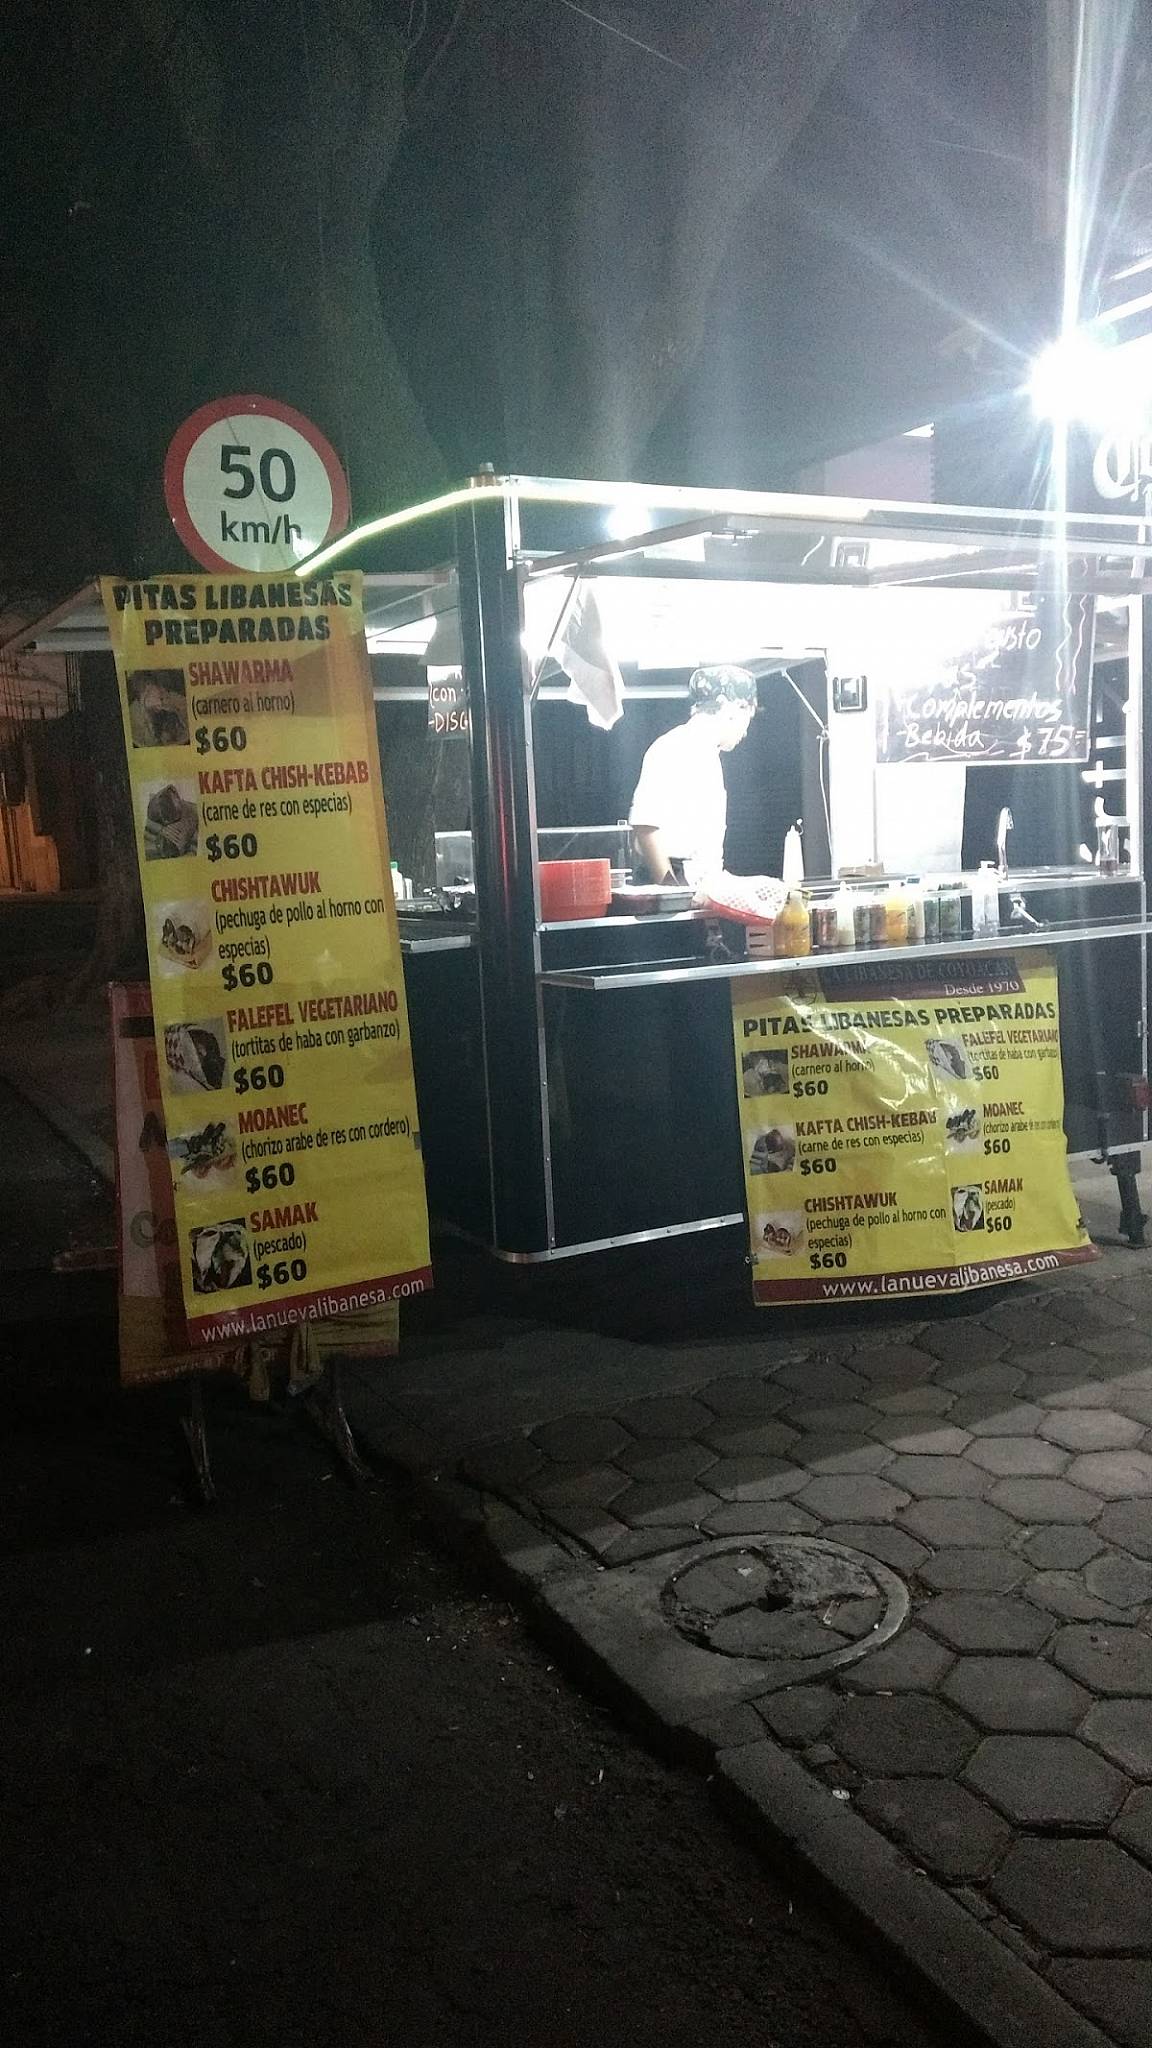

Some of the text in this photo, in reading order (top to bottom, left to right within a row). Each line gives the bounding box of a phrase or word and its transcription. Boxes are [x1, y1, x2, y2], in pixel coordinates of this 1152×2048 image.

[219, 444, 297, 503] 50
[220, 511, 302, 544] km/h
[112, 580, 352, 612] PITAS LIBANESAS
[144, 616, 331, 646] PREPARADAS
[188, 658, 295, 687] SHAWARMA
[192, 684, 296, 720] (carnero al horno)
[195, 726, 247, 756] $60
[198, 760, 369, 795] KAFTA CHISH-KEBAB
[202, 793, 352, 825] (carne de res con especias)
[205, 832, 258, 863] $60
[211, 871, 321, 902] CHISHTAWUK
[215, 897, 385, 933] (pechuga de pollo al horno con
[218, 938, 271, 962] especias)
[222, 961, 273, 992] $60
[945, 979, 1019, 997] Desde 1970
[226, 990, 398, 1033] FALEFEL VEGETARIANO
[743, 1002, 1056, 1037] PITAS LIBANESAS PREPARADAS
[231, 1019, 400, 1061] (tortitas de haba con garbanzo)
[962, 1031, 1005, 1047] FALEFEL
[233, 1064, 285, 1096] $60
[792, 1064, 832, 1078] (carnero
[834, 1061, 843, 1073] al
[972, 1065, 999, 1081] $60
[792, 1080, 828, 1098] $60
[237, 1102, 308, 1135] MOANEC
[796, 1110, 937, 1136] KAFTA CHISH-KEBAB
[983, 1101, 1024, 1118] MOANEC
[241, 1115, 410, 1161] (chorizo arabe de res con cordero)
[798, 1130, 924, 1155] (carne de res con especias)
[984, 1138, 1011, 1155] $60
[245, 1162, 295, 1194] $60
[800, 1157, 837, 1176] $60
[984, 1178, 1024, 1195] SAMAK
[250, 1201, 319, 1234] SAMAK
[804, 1192, 897, 1213] CHISHTAWUK
[986, 1197, 1015, 1214] (pescado)
[806, 1208, 946, 1232] (pechuga de pollo al horno con
[986, 1216, 1012, 1233] $60
[253, 1232, 307, 1260] (pescado)
[808, 1235, 852, 1251] especias)
[256, 1259, 307, 1290] $60
[810, 1252, 847, 1270] $60
[822, 1253, 1059, 1297] www.lanuevalibanesa.com
[201, 1276, 425, 1344] www.lanuevalibanesa.com
